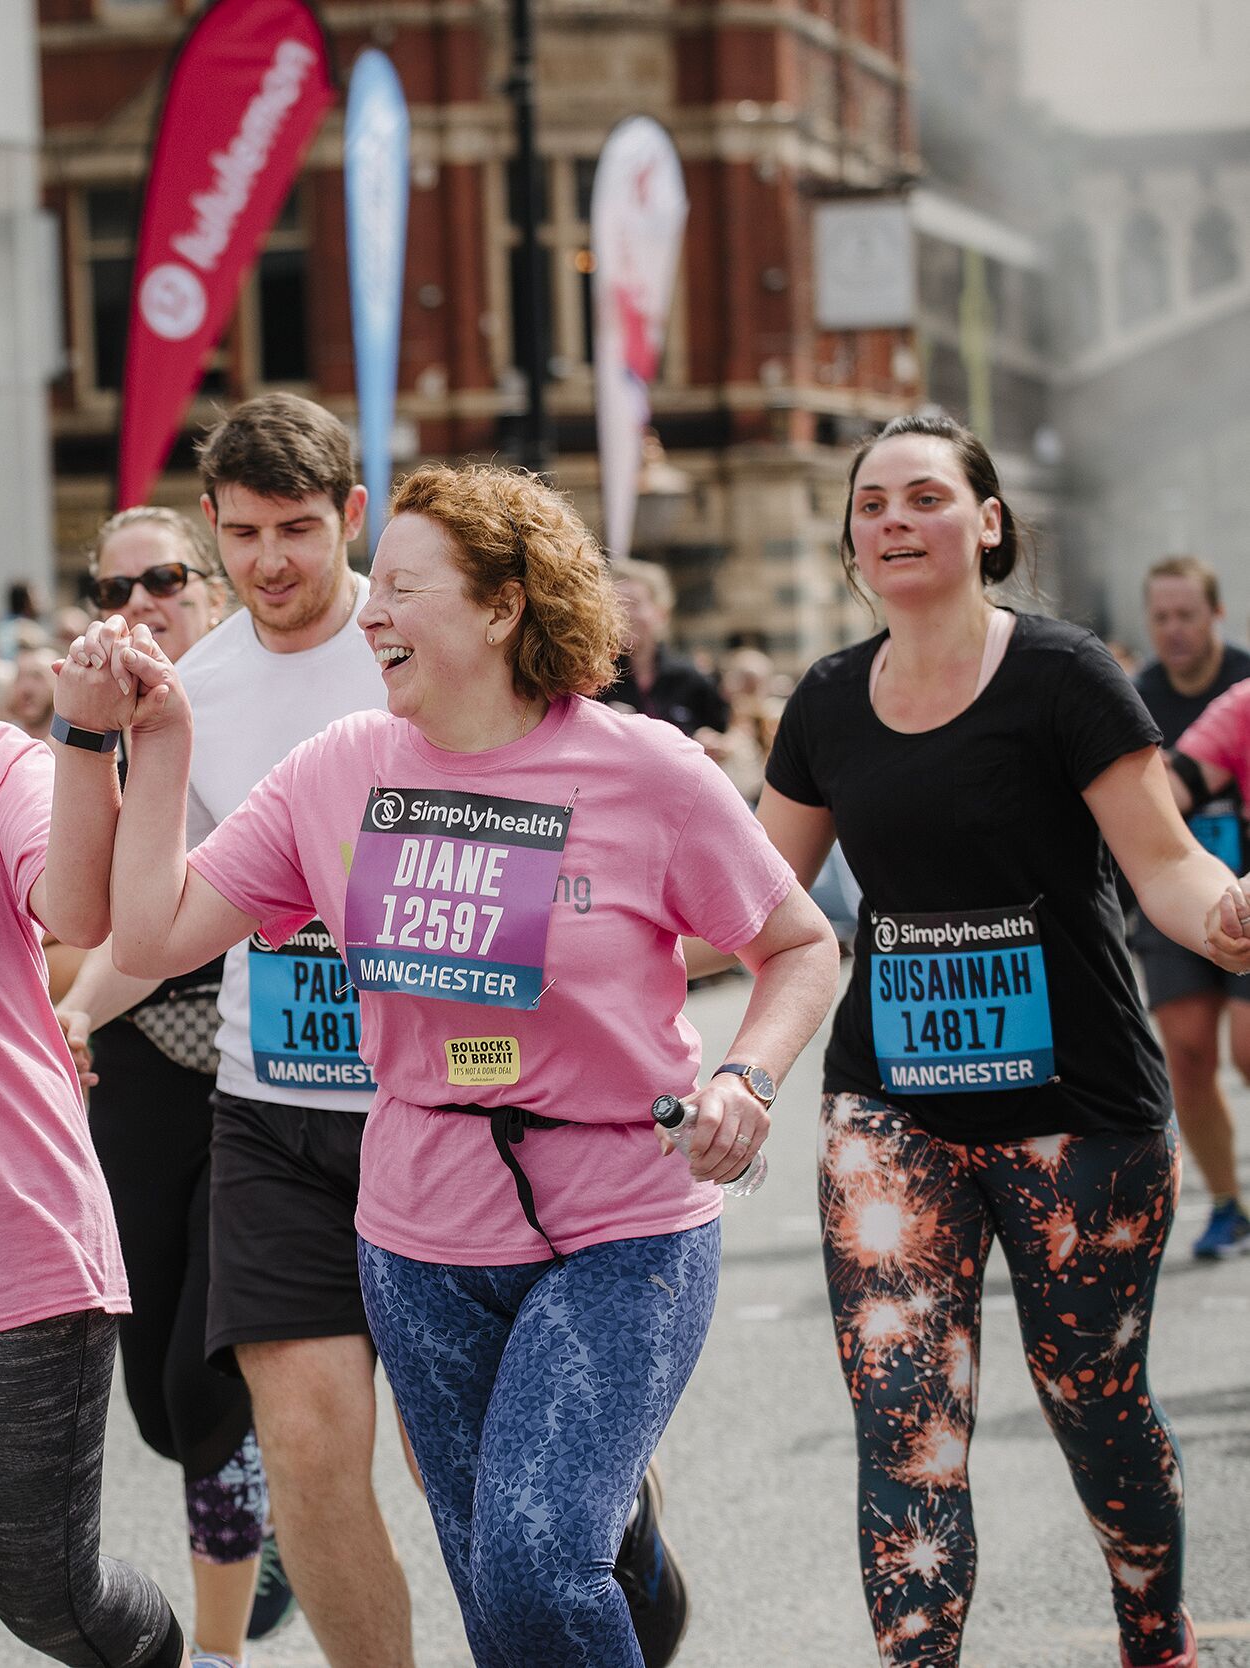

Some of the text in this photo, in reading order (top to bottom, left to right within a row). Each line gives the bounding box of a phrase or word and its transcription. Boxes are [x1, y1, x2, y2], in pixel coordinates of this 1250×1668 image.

[409, 801, 563, 838] Simplyhealth
[393, 838, 509, 897] DIANE
[375, 894, 504, 955] 12597
[900, 916, 1034, 948] Simplyhealth
[360, 958, 516, 998] MANCHESTER
[879, 952, 1032, 1003] SUSANNAH
[282, 1009, 359, 1052] 1481
[451, 1040, 511, 1053] BOLLOCKS
[901, 1006, 1006, 1053] 14817
[268, 1060, 376, 1084] MANCHEST
[452, 1052, 513, 1065] TO BREXIT
[891, 1059, 1034, 1087] MANCHESTER
